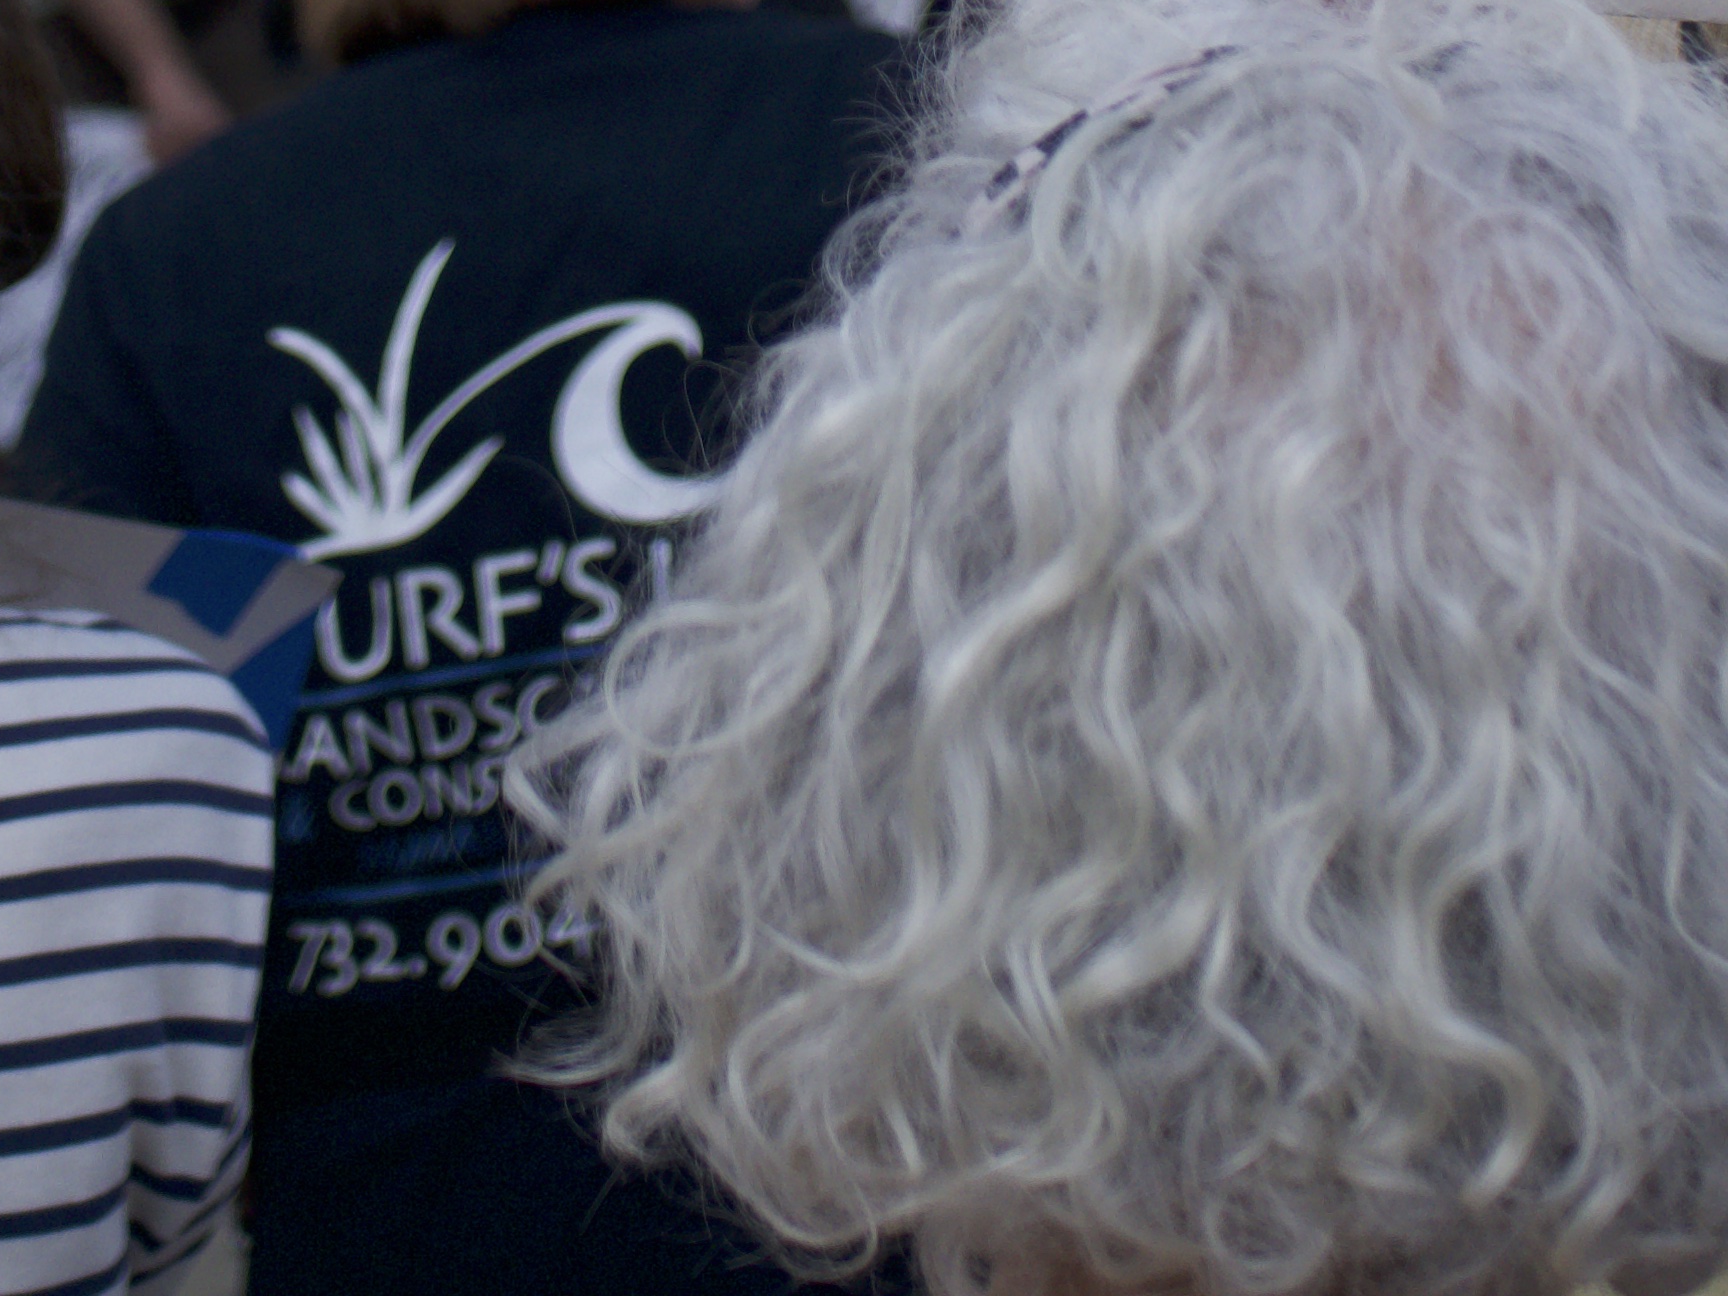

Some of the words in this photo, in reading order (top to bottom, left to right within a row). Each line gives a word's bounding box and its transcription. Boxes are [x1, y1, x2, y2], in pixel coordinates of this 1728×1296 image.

[314, 537, 623, 684] URF'S
[279, 674, 562, 783] ANDSC
[328, 755, 505, 832] CONS
[287, 900, 600, 996] 732.904
